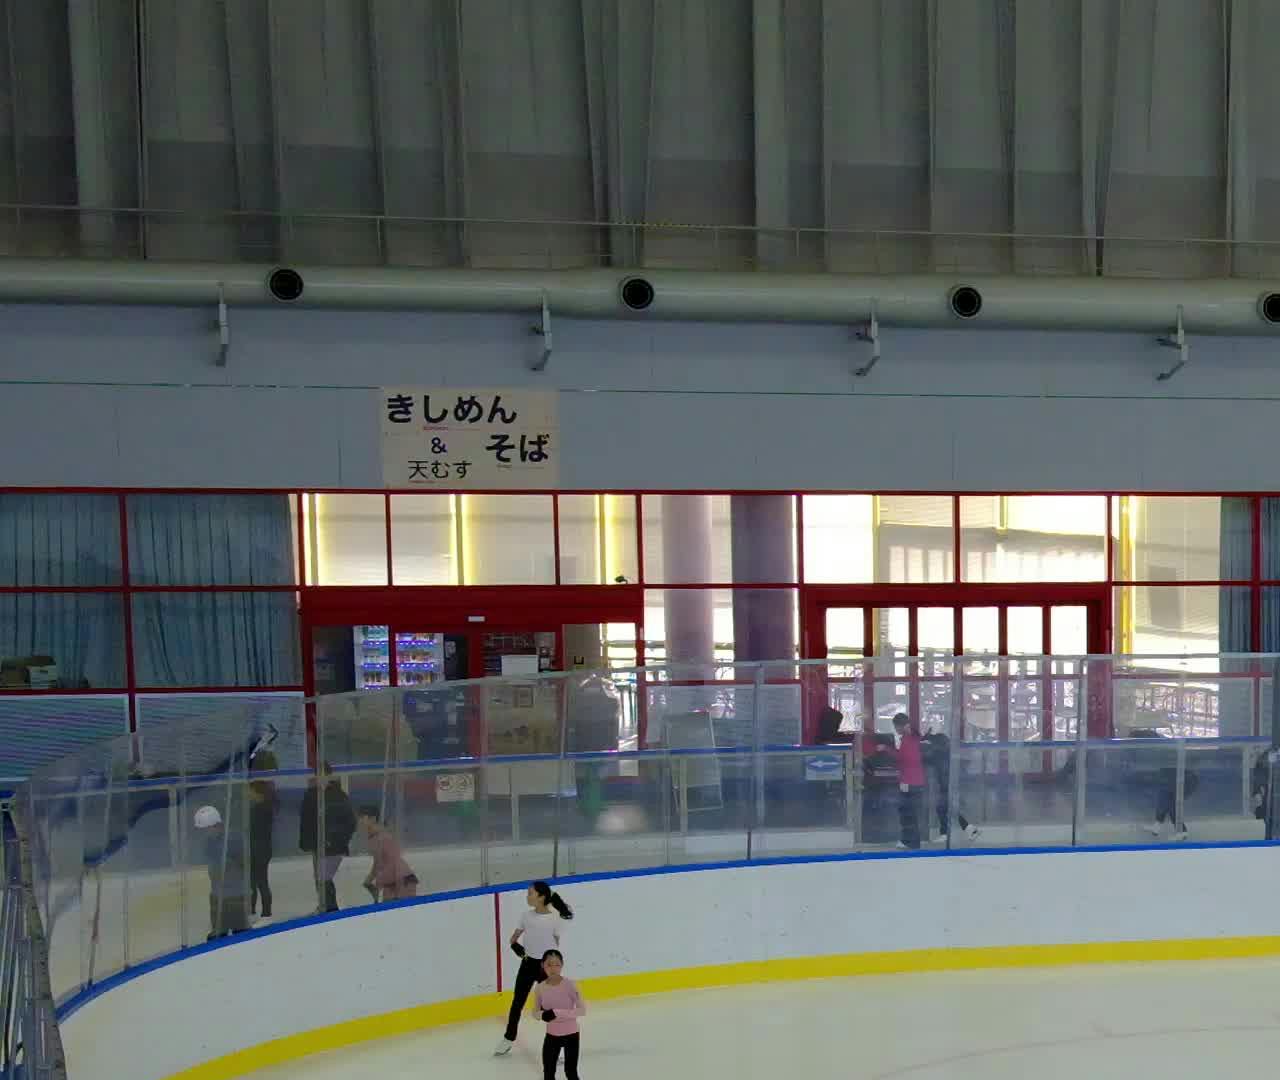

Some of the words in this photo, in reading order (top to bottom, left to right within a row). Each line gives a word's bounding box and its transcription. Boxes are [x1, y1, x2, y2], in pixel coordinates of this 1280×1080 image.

[387, 394, 517, 424] きしめん
[431, 437, 447, 454] &
[486, 434, 550, 463] そば
[408, 460, 472, 479] 天むす
